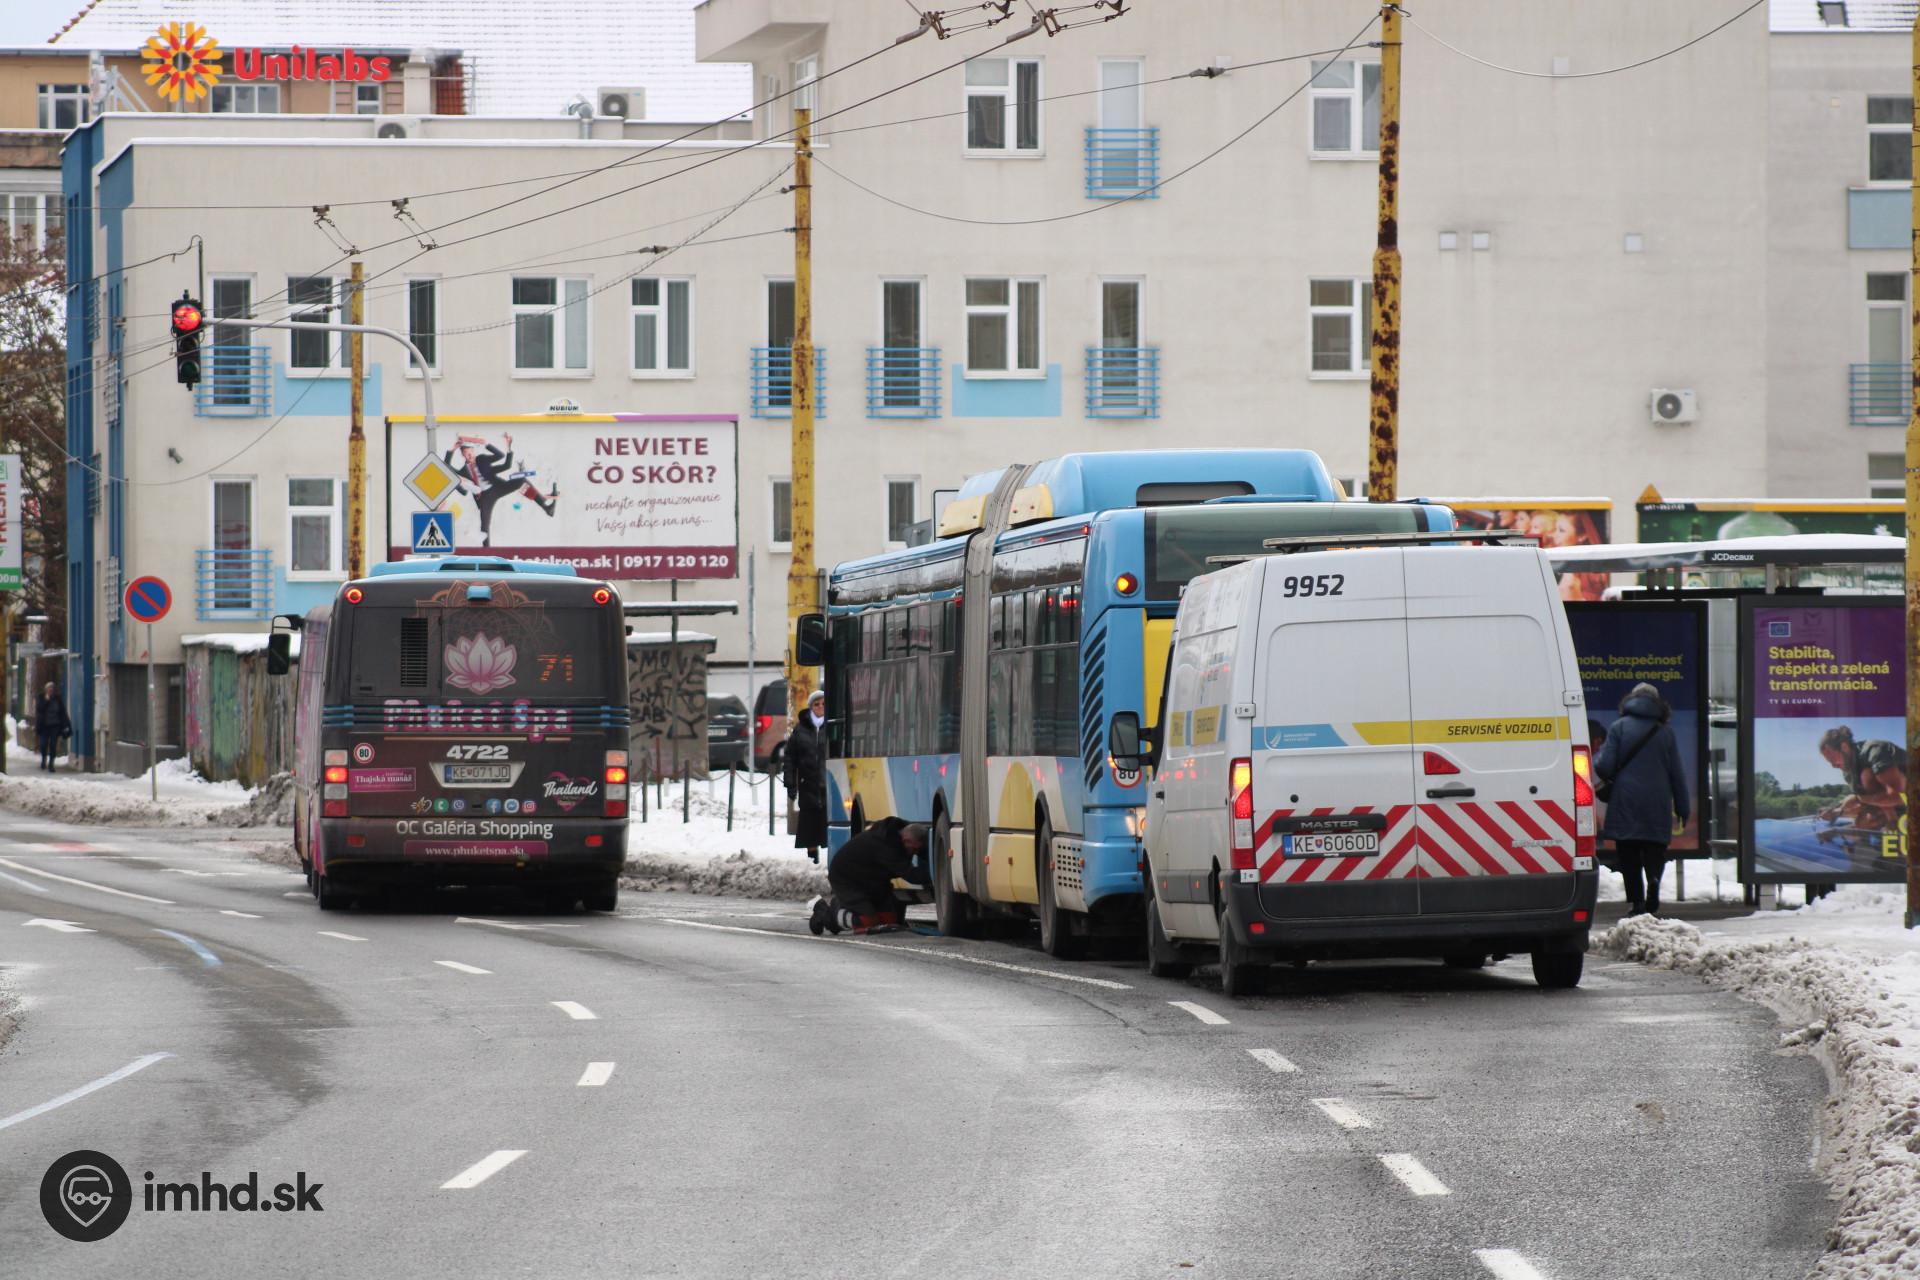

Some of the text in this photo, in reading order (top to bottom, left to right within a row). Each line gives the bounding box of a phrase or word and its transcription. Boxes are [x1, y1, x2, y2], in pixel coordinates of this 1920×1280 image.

[234, 45, 392, 81] Unilabs
[594, 437, 709, 456] NEVIETE
[587, 461, 717, 484] ČO SKÔR?
[585, 493, 721, 515] nechajte organizovanie
[597, 517, 627, 536] Vašej
[662, 516, 681, 527] na
[623, 555, 662, 568] 0917
[667, 555, 696, 568] 120
[699, 554, 729, 568] 120
[1711, 553, 1755, 561] JCDecaux
[1283, 574, 1345, 598] 9952
[1609, 653, 1683, 667] bezpečnosť
[1769, 646, 1835, 660] Stabilita,
[536, 654, 574, 681] 71
[1635, 668, 1684, 682] energia.
[1769, 660, 1890, 677] rešpekt a zelená
[1769, 677, 1878, 691] transformácia.
[384, 699, 574, 743] Phuket Spa
[1447, 722, 1553, 736] SERVISNÉ VOZIDLO
[359, 748, 370, 758] 80
[446, 744, 510, 760] 4722
[453, 767, 466, 778] KE
[543, 780, 599, 798] Thailand
[396, 819, 554, 839] OC Galéria Shopping
[1300, 820, 1359, 829] MASTER
[1294, 836, 1315, 852] KE
